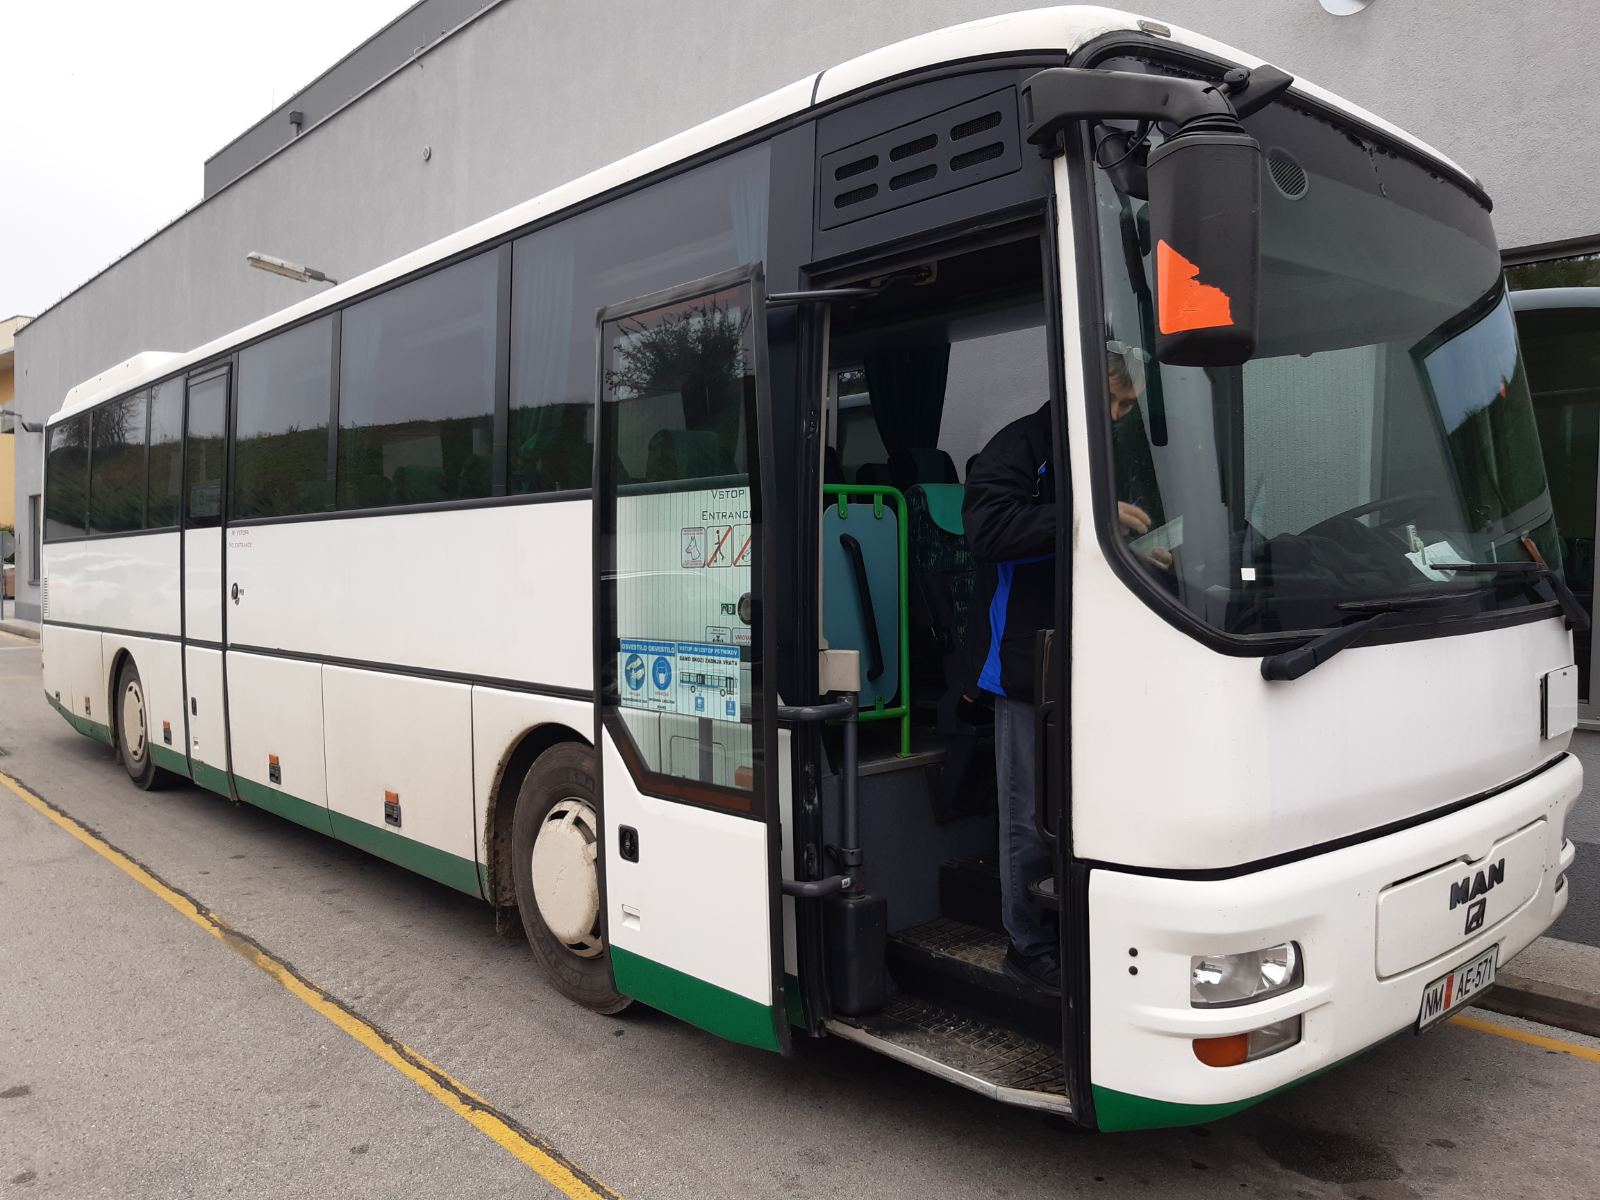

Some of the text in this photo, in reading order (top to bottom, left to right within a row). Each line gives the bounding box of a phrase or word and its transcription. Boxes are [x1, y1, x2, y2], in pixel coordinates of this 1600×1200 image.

[711, 489, 745, 500] VSTOP
[1449, 857, 1505, 910] MAN
[1423, 954, 1493, 1020] NM AE-571
